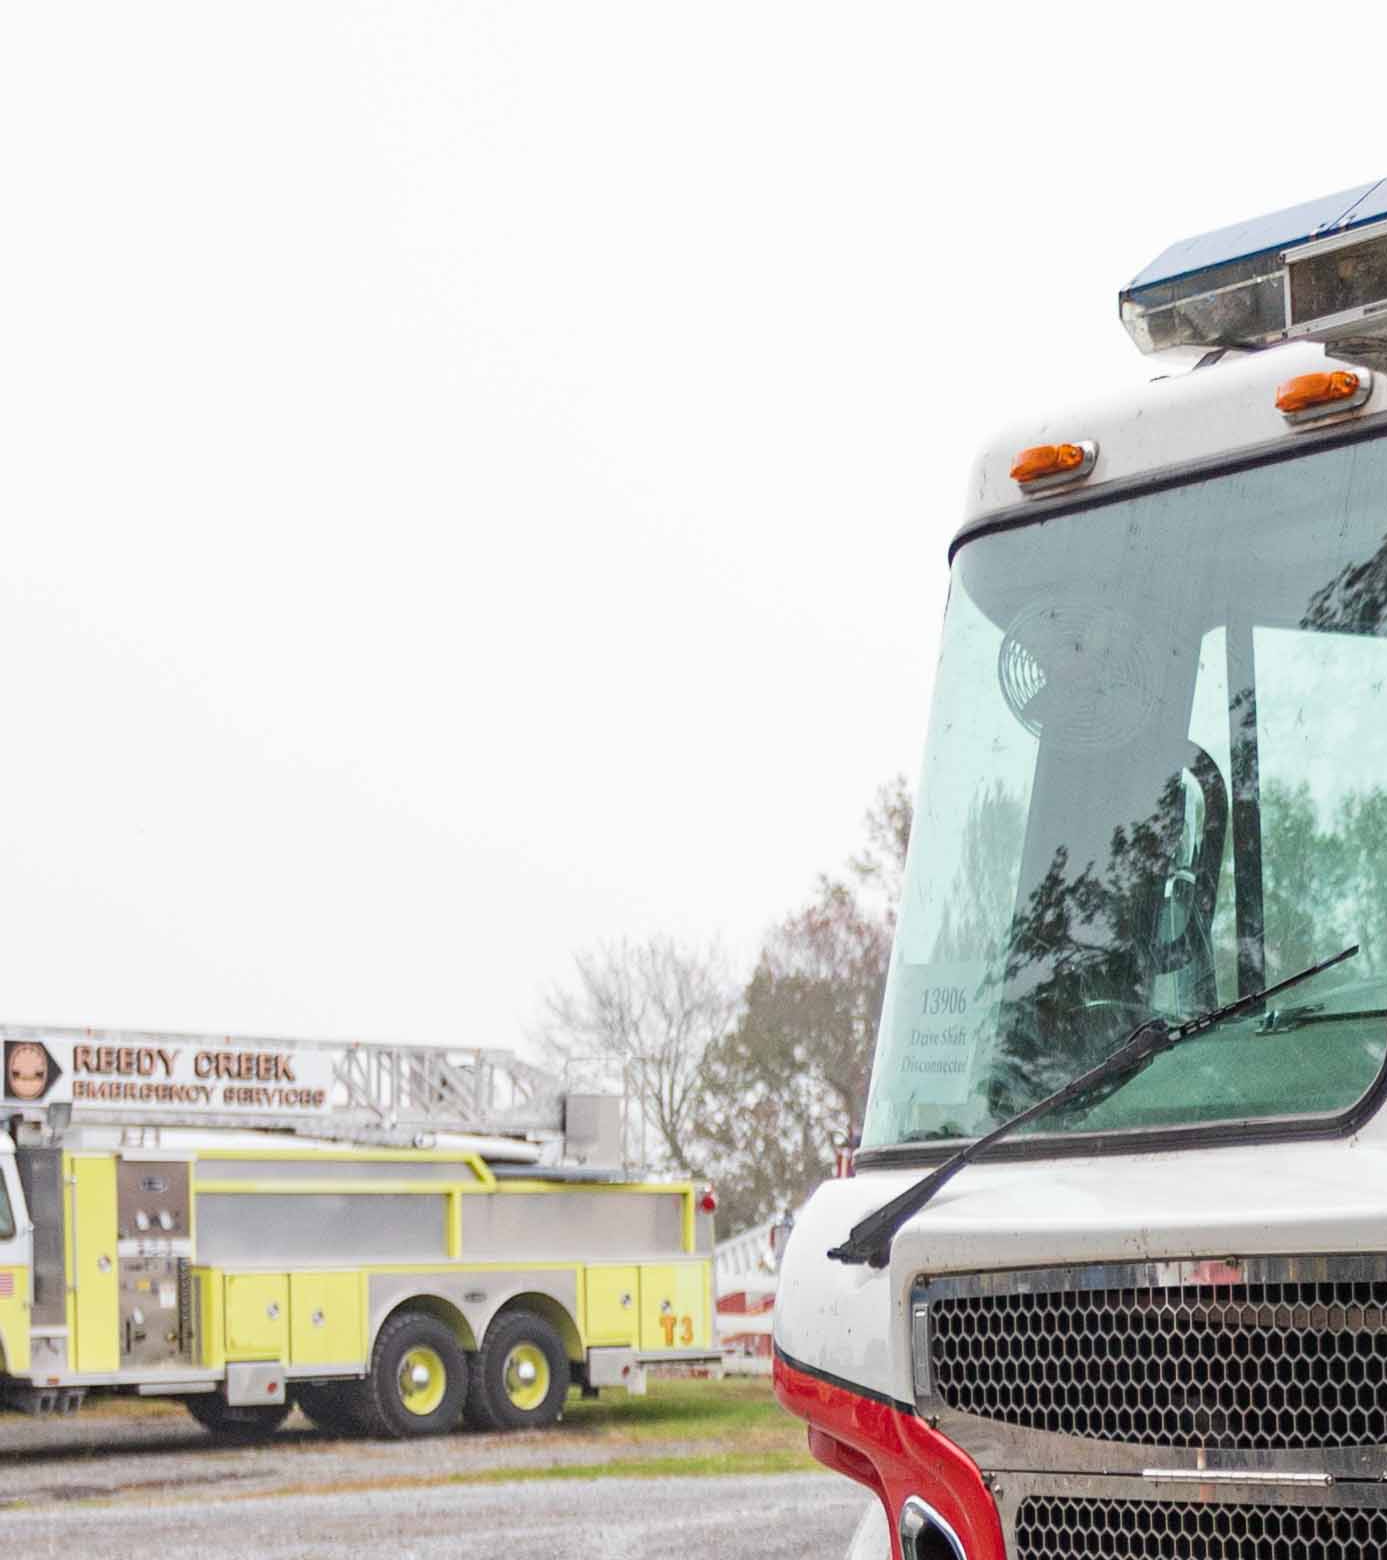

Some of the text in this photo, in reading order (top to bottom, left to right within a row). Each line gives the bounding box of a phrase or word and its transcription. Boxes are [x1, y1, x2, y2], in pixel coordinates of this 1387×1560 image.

[921, 987, 967, 1015] 13906
[73, 1046, 296, 1081] REEDY CREEK
[72, 1080, 326, 1108] EMERGENCY SERVICES
